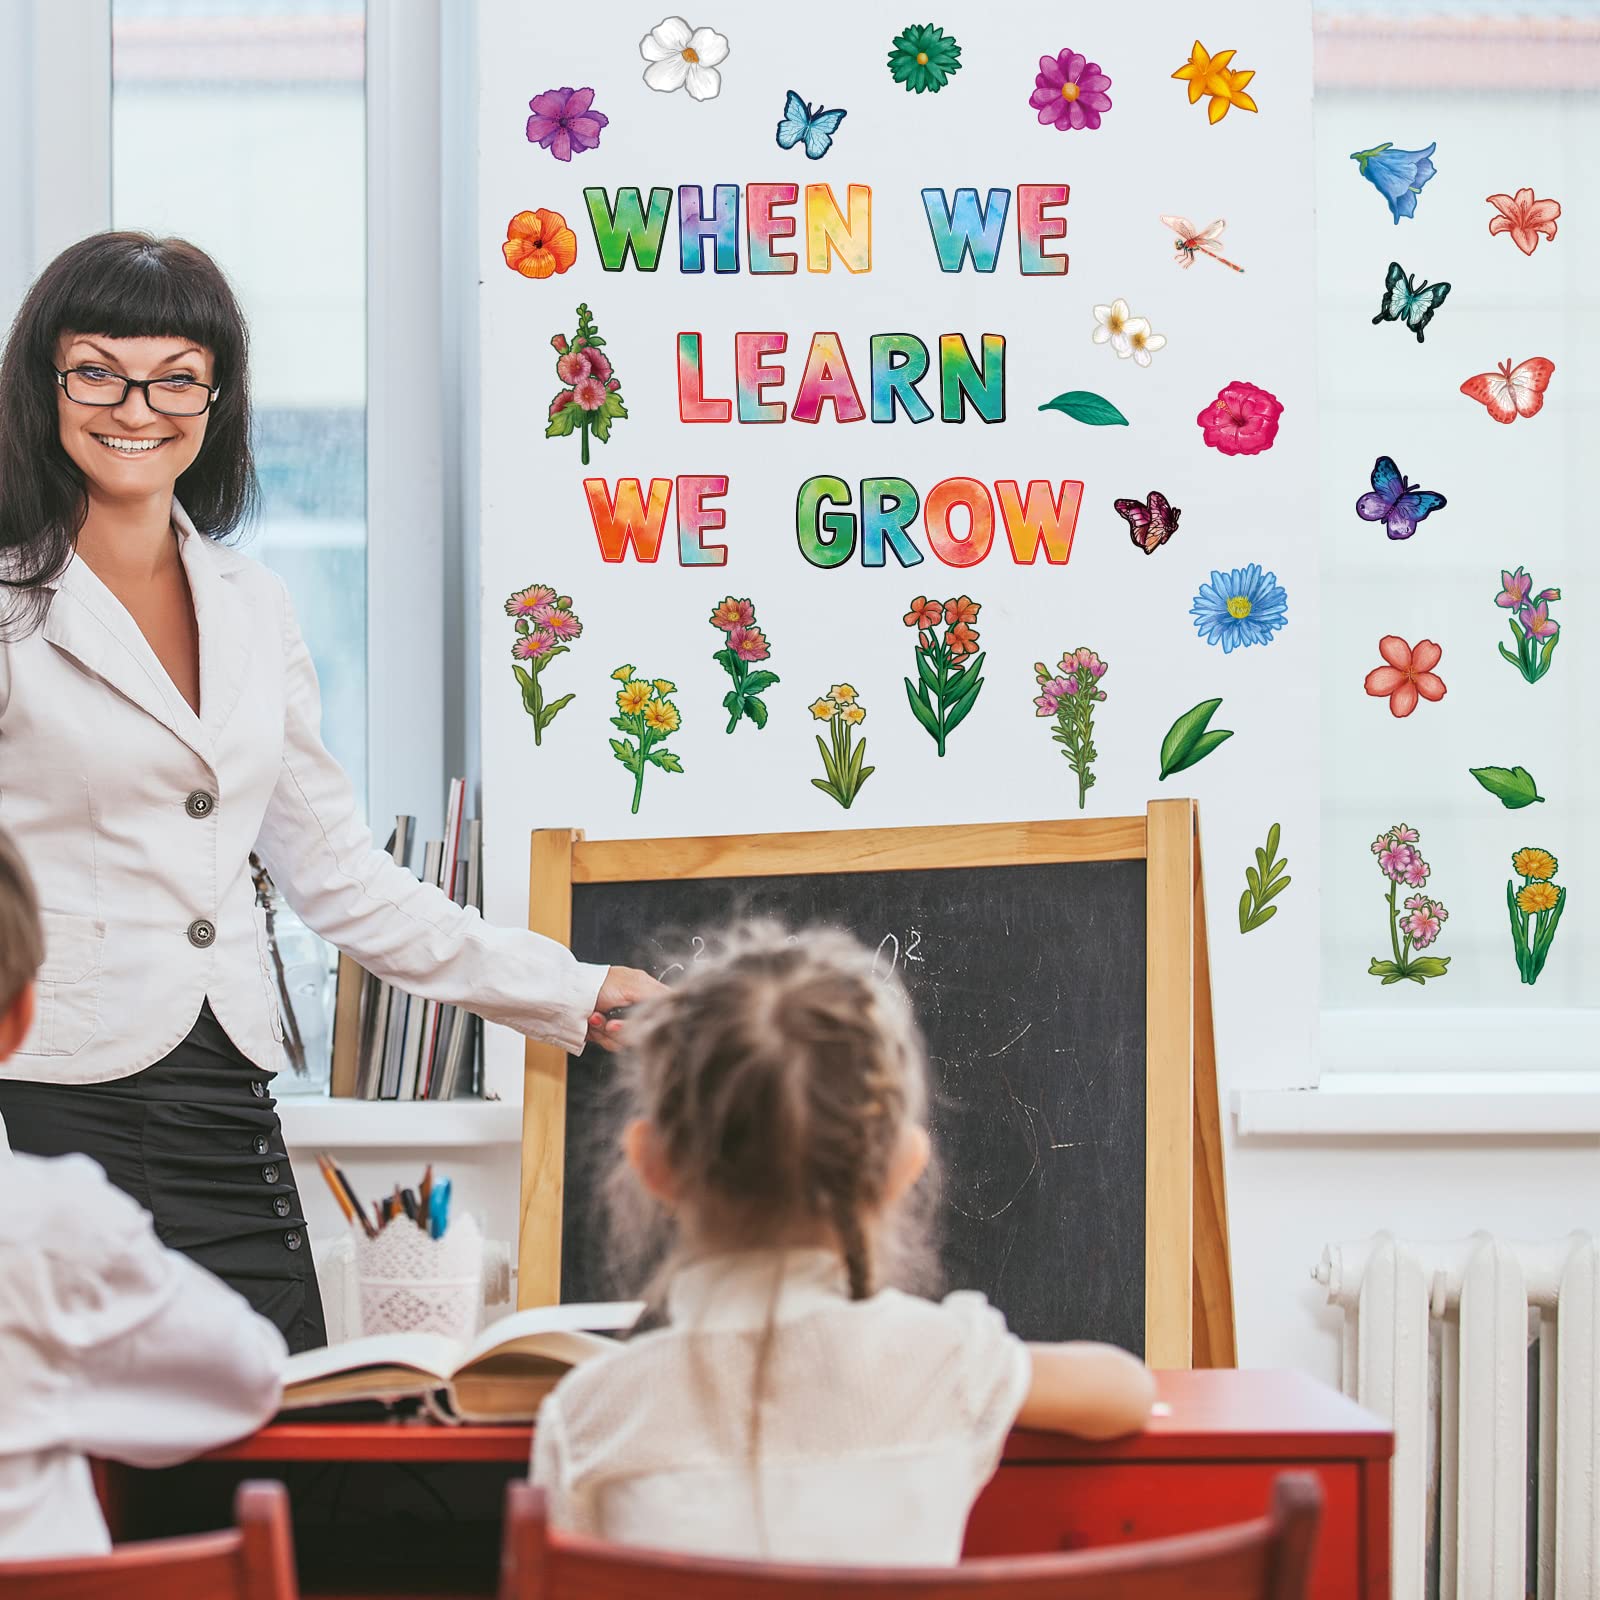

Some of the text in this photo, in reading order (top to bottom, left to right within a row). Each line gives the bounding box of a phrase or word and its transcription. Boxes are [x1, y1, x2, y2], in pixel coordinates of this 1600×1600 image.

[583, 183, 1070, 276] WHEN WE
[677, 332, 1006, 424] LEARN
[583, 475, 1084, 569] WE GROW
